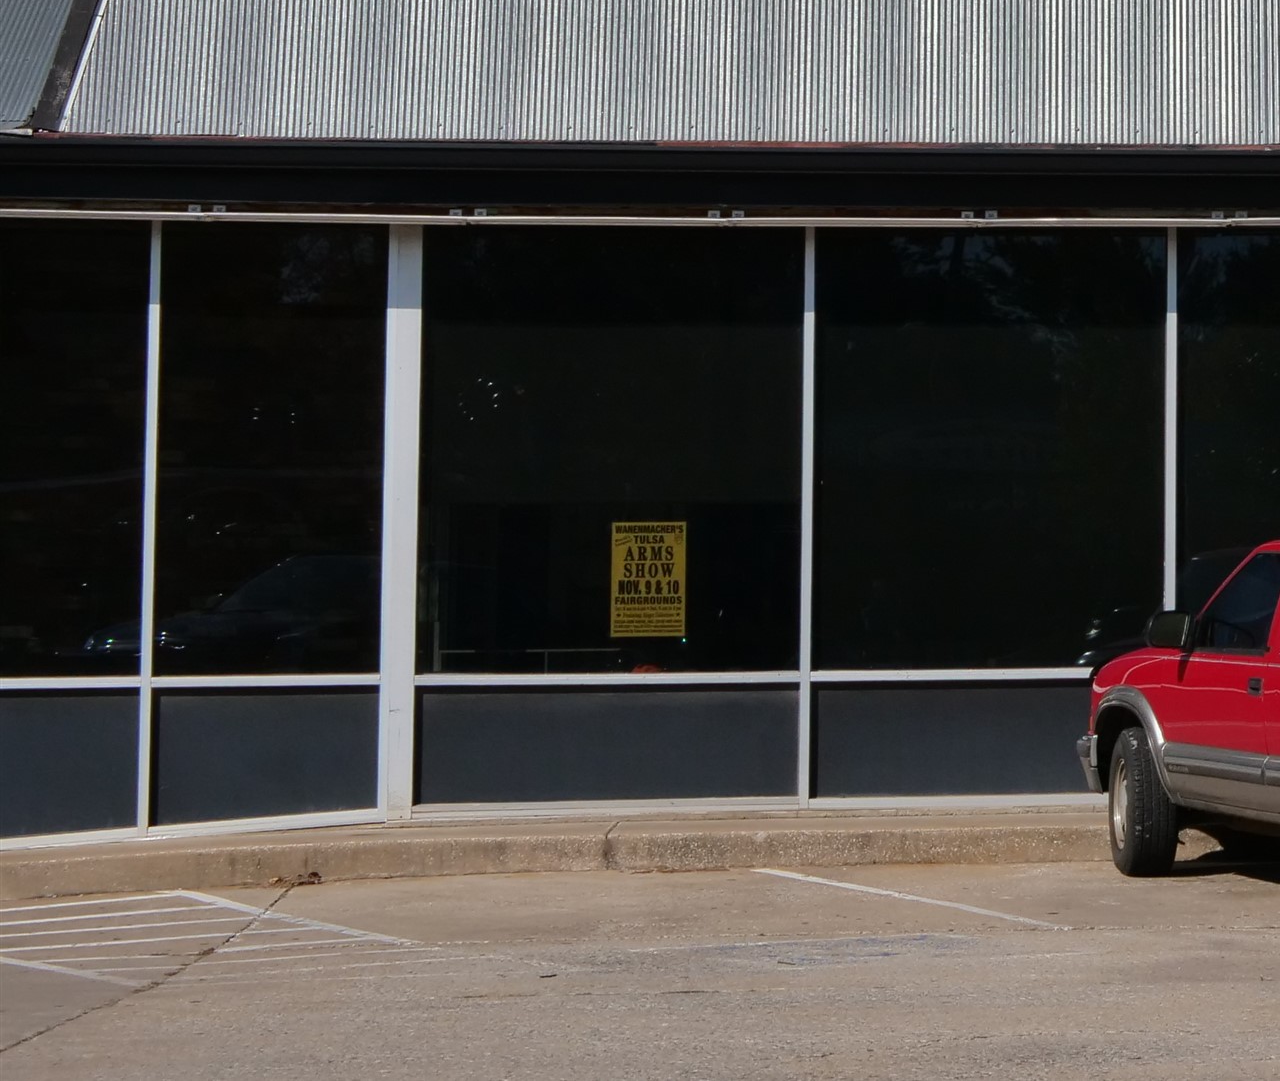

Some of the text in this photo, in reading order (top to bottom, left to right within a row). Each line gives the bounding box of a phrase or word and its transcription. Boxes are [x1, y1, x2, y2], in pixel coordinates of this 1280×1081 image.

[633, 535, 665, 544] TULSA
[624, 545, 674, 561] ARMS
[623, 563, 675, 578] SHOW
[618, 580, 680, 595] NOV. 9 & 10
[614, 596, 683, 605] FAIRGROUNDS
